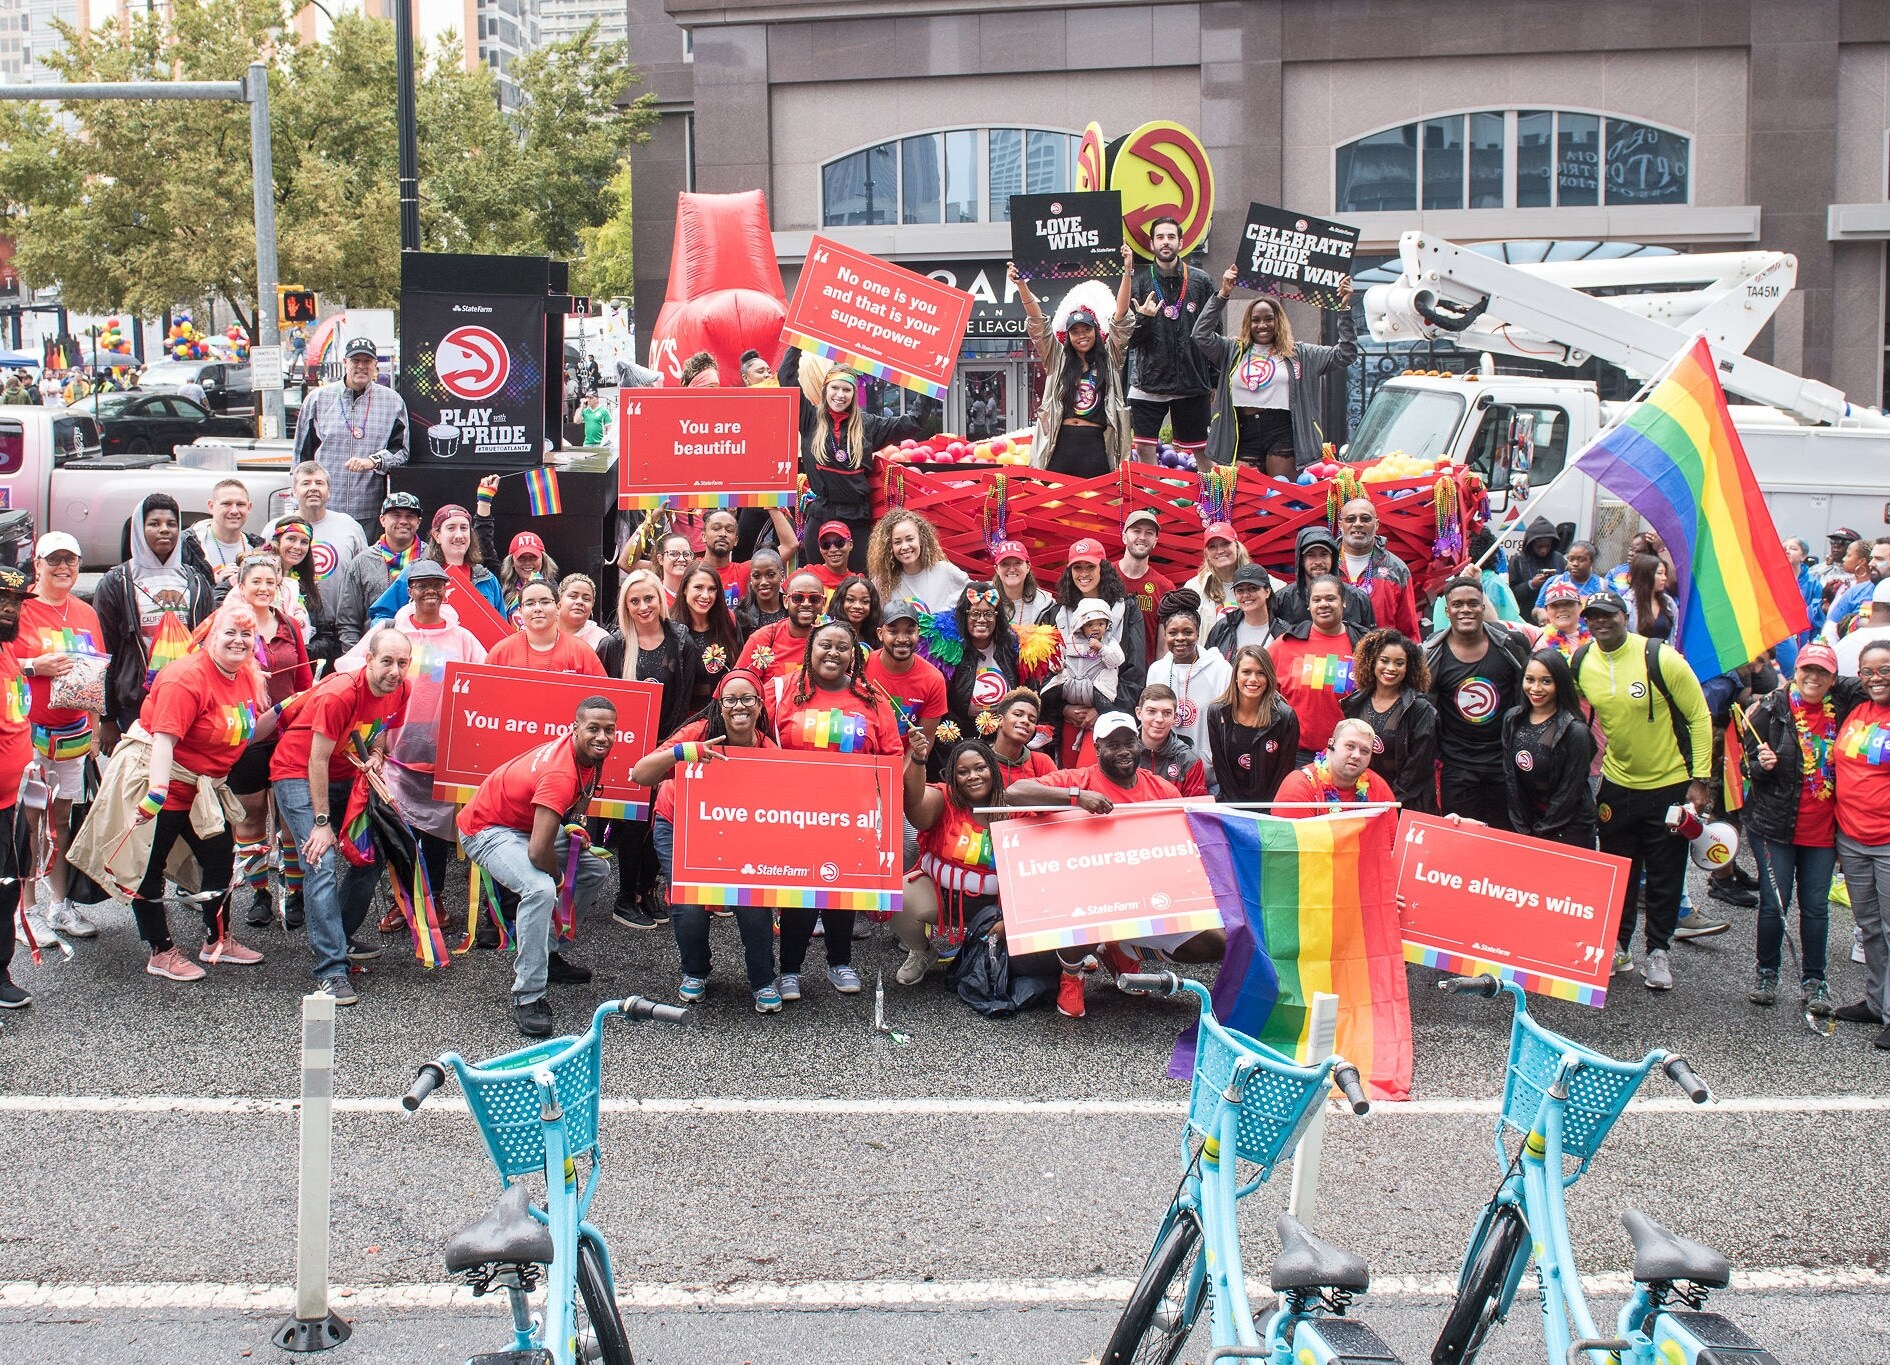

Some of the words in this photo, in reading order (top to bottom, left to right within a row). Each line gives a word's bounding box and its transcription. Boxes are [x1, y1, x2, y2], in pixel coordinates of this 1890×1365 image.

[1036, 216, 1082, 236] LOVE
[1048, 230, 1099, 250] WINS
[1246, 223, 1354, 258] CELEBRATE
[1252, 241, 1311, 266] PRIDE
[1251, 255, 1299, 280] YOUR
[1304, 265, 1346, 288] WAY
[837, 266, 859, 285] No
[862, 279, 891, 297] one
[894, 288, 907, 304] is
[908, 297, 937, 316] you
[1747, 286, 1779, 297] TA45M
[822, 285, 853, 304] and
[855, 295, 887, 317] that
[889, 307, 903, 322] is
[904, 316, 940, 336] your
[831, 309, 921, 349] superpower
[980, 320, 1027, 333] LEAGU
[440, 408, 492, 426] PLAY
[493, 414, 506, 422] with
[462, 426, 526, 445] PRIDE
[679, 419, 709, 434] You
[714, 422, 741, 434] are
[674, 440, 746, 455] beautiful
[518, 535, 537, 547] ATL
[1000, 542, 1021, 554] ATL
[6, 691, 32, 706] Prid
[227, 715, 256, 730] Prid
[464, 710, 499, 730] You
[505, 717, 538, 734] are
[544, 721, 574, 736] not
[804, 718, 865, 736] Pride
[700, 801, 748, 822] Love
[754, 808, 850, 829] conquers
[958, 835, 989, 855] Pri
[756, 864, 808, 876] StateFarm
[1019, 859, 1060, 877] Live
[1414, 862, 1462, 889] Love
[1468, 877, 1539, 908] always
[1546, 896, 1595, 920] wins
[1087, 901, 1139, 914] StateFarm
